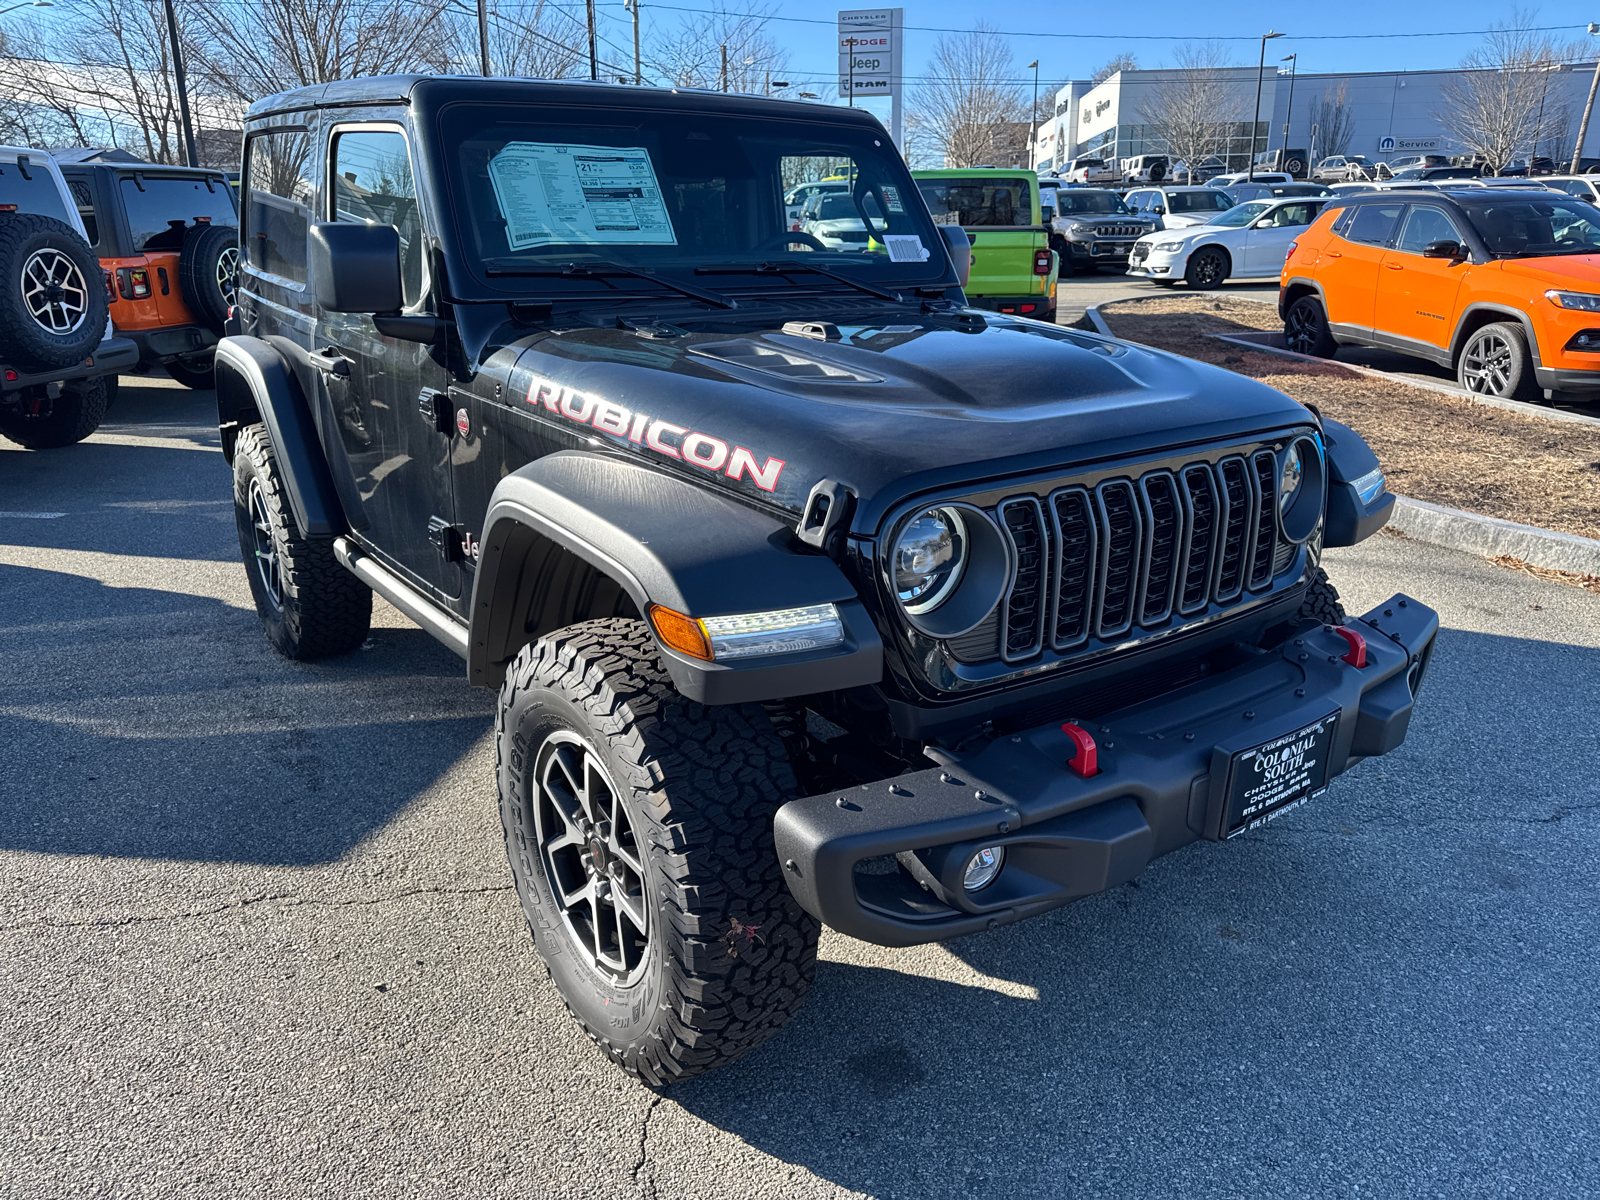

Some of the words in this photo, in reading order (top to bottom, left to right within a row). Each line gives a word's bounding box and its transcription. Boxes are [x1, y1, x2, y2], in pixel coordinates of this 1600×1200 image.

[841, 38, 887, 47] DODGE
[848, 56, 880, 70] Jeep
[855, 80, 887, 88] RAM
[1398, 140, 1436, 148] Service
[580, 163, 592, 172] 21
[525, 374, 786, 493] RUBICON
[1253, 734, 1316, 773] COLONIAL
[1262, 752, 1305, 783] SOUTH
[1244, 770, 1297, 798] CHRYSLER
[1250, 783, 1285, 804] DODGE
[1258, 802, 1263, 810] 6
[1301, 778, 1311, 788] MA
